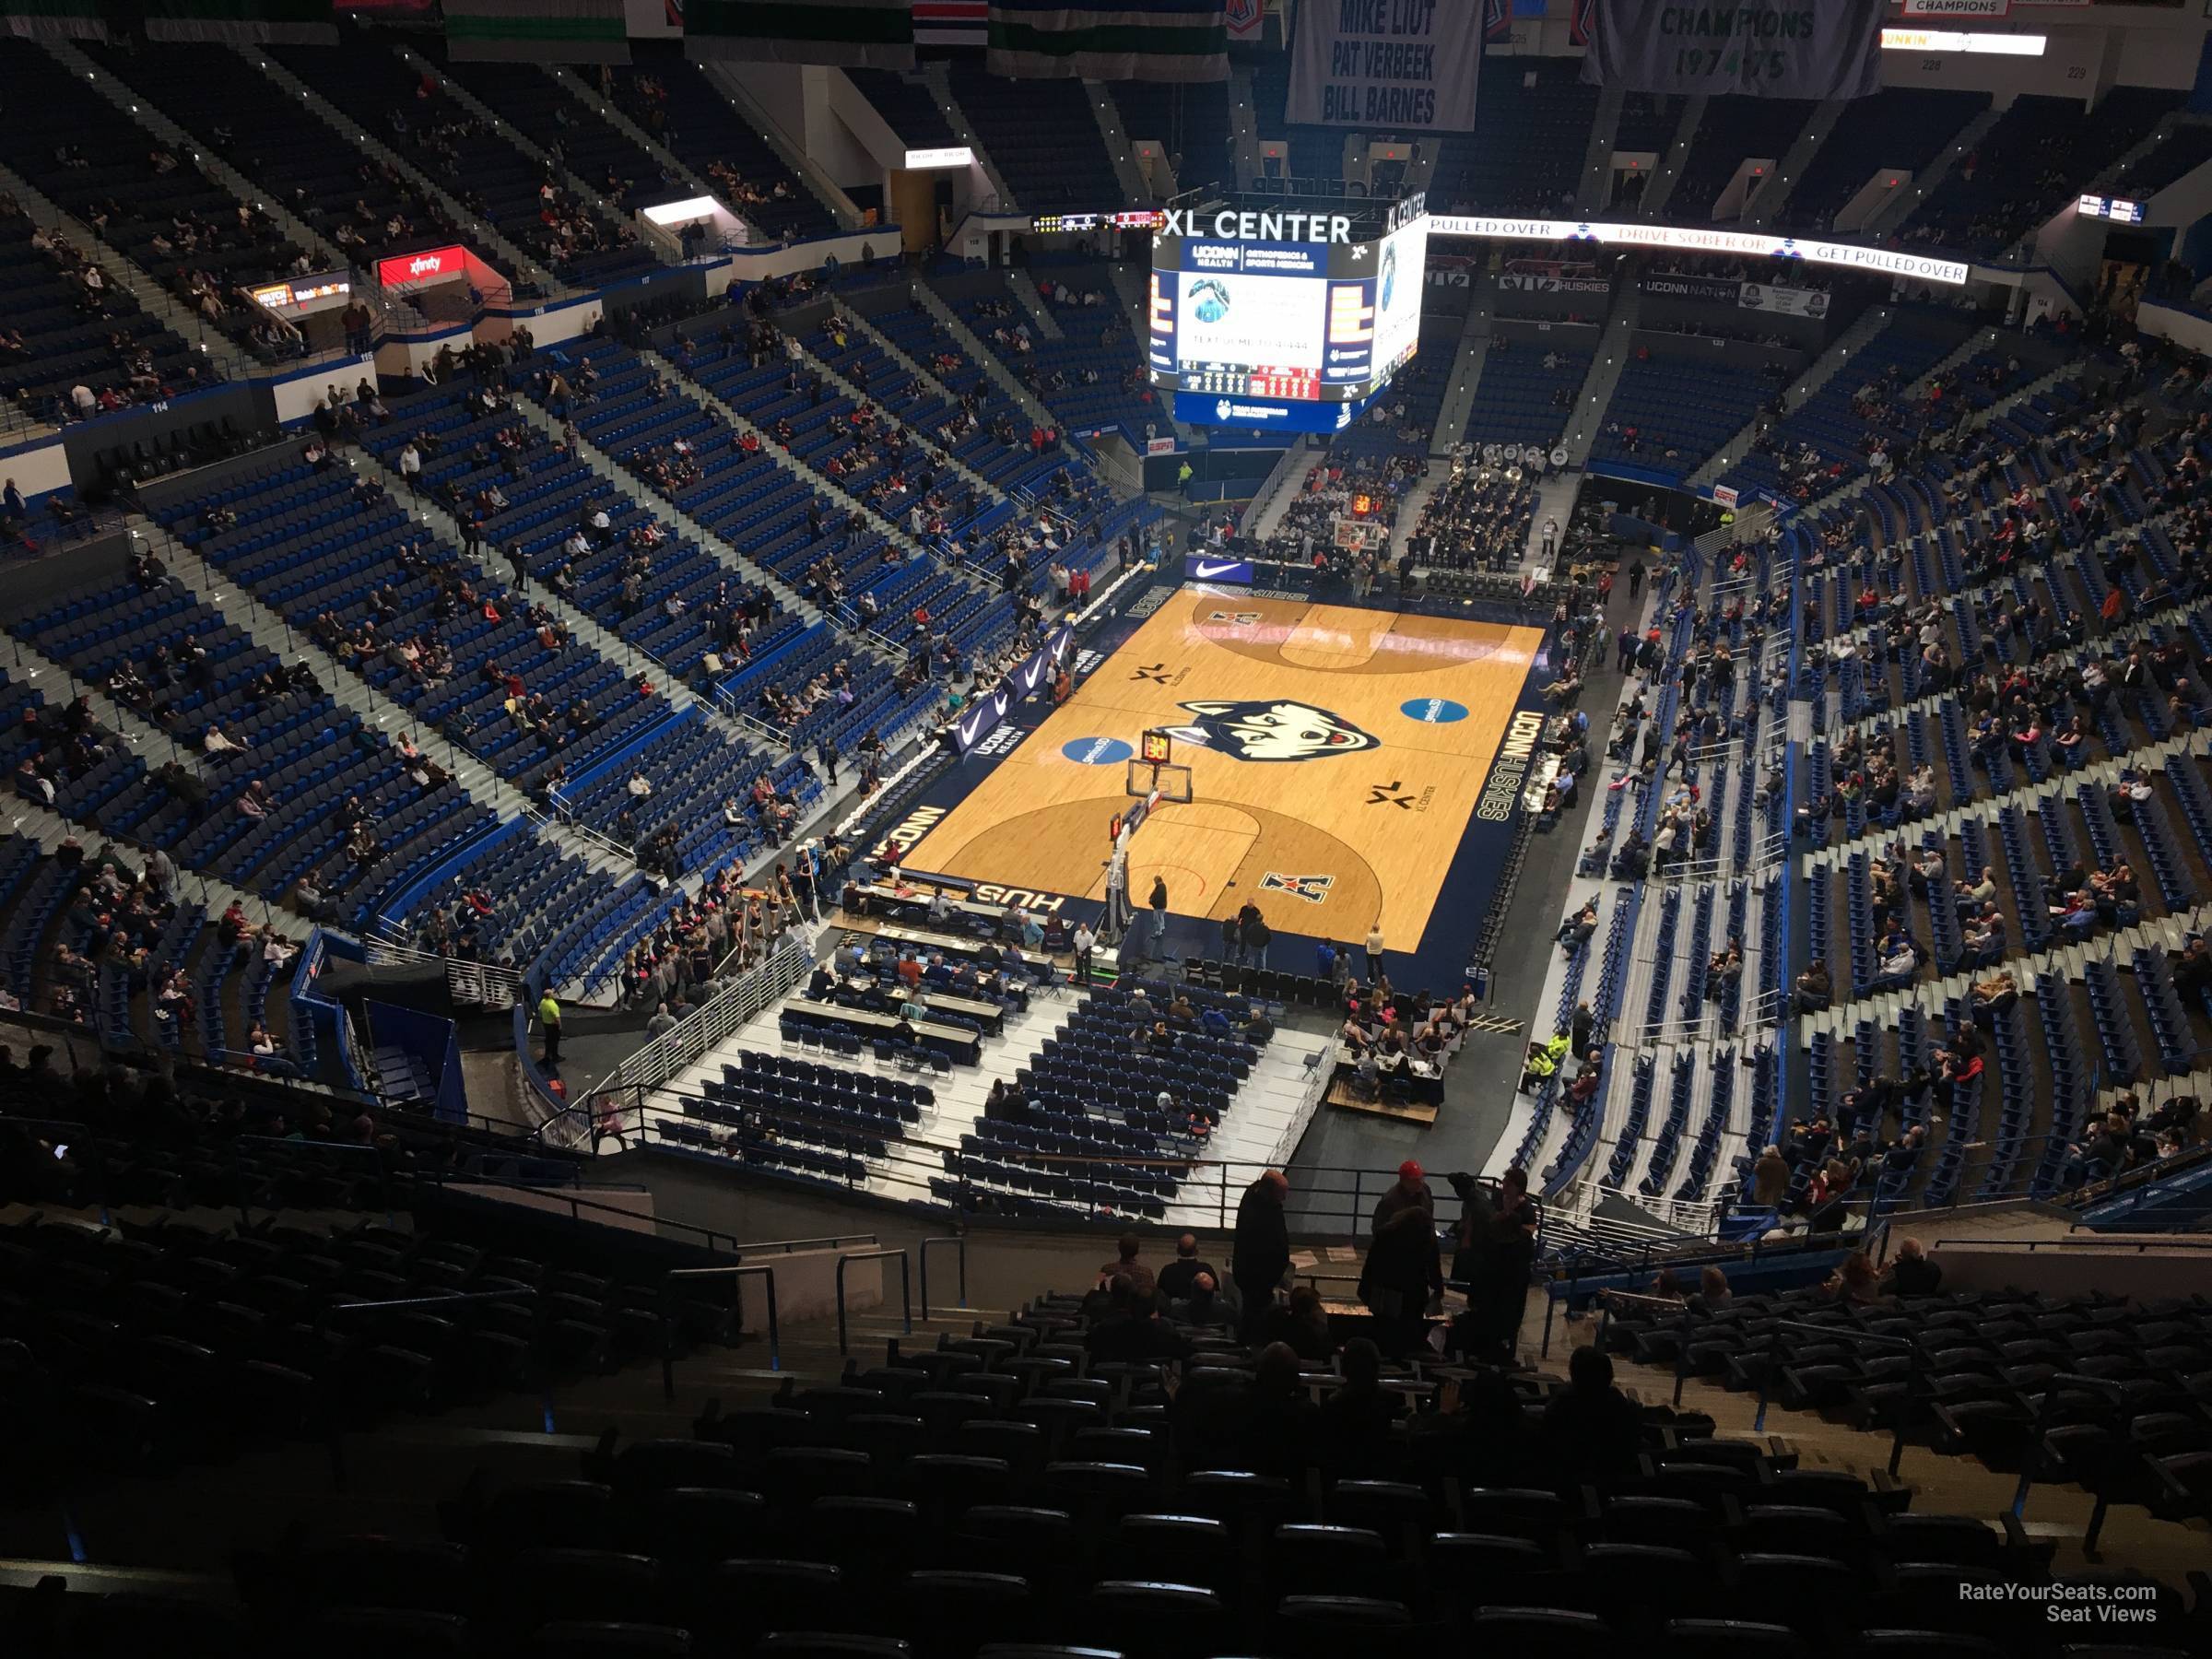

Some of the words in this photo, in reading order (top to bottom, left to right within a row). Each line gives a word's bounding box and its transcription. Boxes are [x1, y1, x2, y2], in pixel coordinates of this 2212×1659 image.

[1338, 0, 1386, 34] MIKE
[1916, 0, 1997, 12] CHAMPIONS
[1660, 7, 1815, 38] CHAMPIONS
[1332, 41, 1360, 76] PAT
[1364, 42, 1435, 81] VERBEEK
[1323, 85, 1359, 121] BILL
[1364, 87, 1436, 124] BARNES
[1161, 208, 1205, 237] XL
[1215, 210, 1351, 244] CENTER
[1430, 218, 1498, 233] PULLED
[1502, 222, 1551, 236] OVER
[1618, 228, 1669, 242] DRIVE
[1677, 231, 1736, 248] SOBER
[1741, 239, 1767, 250] OR
[410, 256, 441, 276] xfinity
[1192, 245, 1239, 260] UCONN
[1817, 246, 1849, 261] GET
[1855, 250, 1915, 272] PULLED
[1919, 261, 1964, 281] OVER
[1559, 280, 1609, 293] HUSKIES
[1646, 280, 1688, 294] UCONN
[152, 401, 168, 413] 114
[974, 725, 1016, 756] UCONN
[995, 731, 1025, 754] HEALTH
[1501, 711, 1545, 759] UCONN
[1477, 754, 1530, 822] HUSKIES
